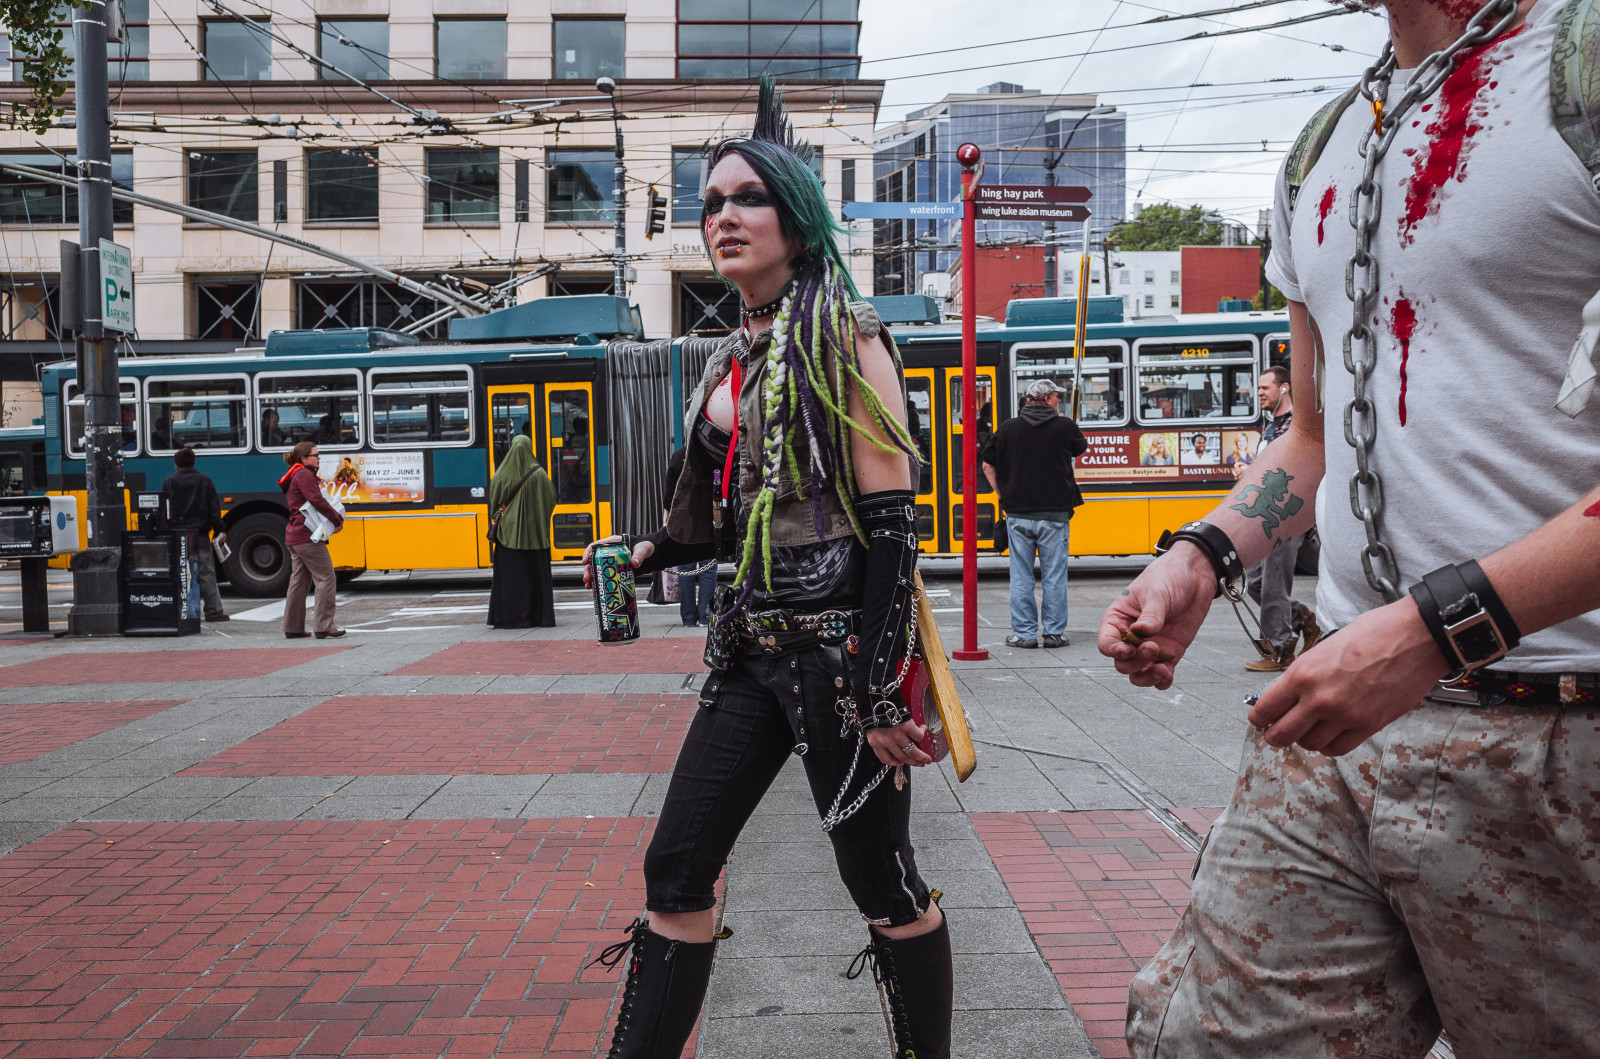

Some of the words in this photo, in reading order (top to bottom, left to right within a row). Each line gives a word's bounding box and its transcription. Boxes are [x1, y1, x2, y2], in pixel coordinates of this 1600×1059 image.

[981, 188, 1002, 199] hing
[1004, 188, 1021, 199] hay
[1023, 189, 1044, 200] park
[909, 205, 955, 215] waterfront
[981, 206, 1001, 217] wing
[1001, 207, 1018, 216] luke
[1018, 208, 1039, 216] asian
[1039, 209, 1073, 217] museum
[673, 243, 707, 254] SUM
[102, 249, 130, 268] INTERNATIONAL
[108, 264, 125, 278] DISTRICT
[1181, 348, 1210, 358] 4210
[1085, 435, 1130, 445] URTURE
[1081, 455, 1129, 465] CALLING
[1183, 467, 1212, 475] BASTYR
[596, 564, 605, 601] ENERGY
[600, 602, 609, 631] DRINK
